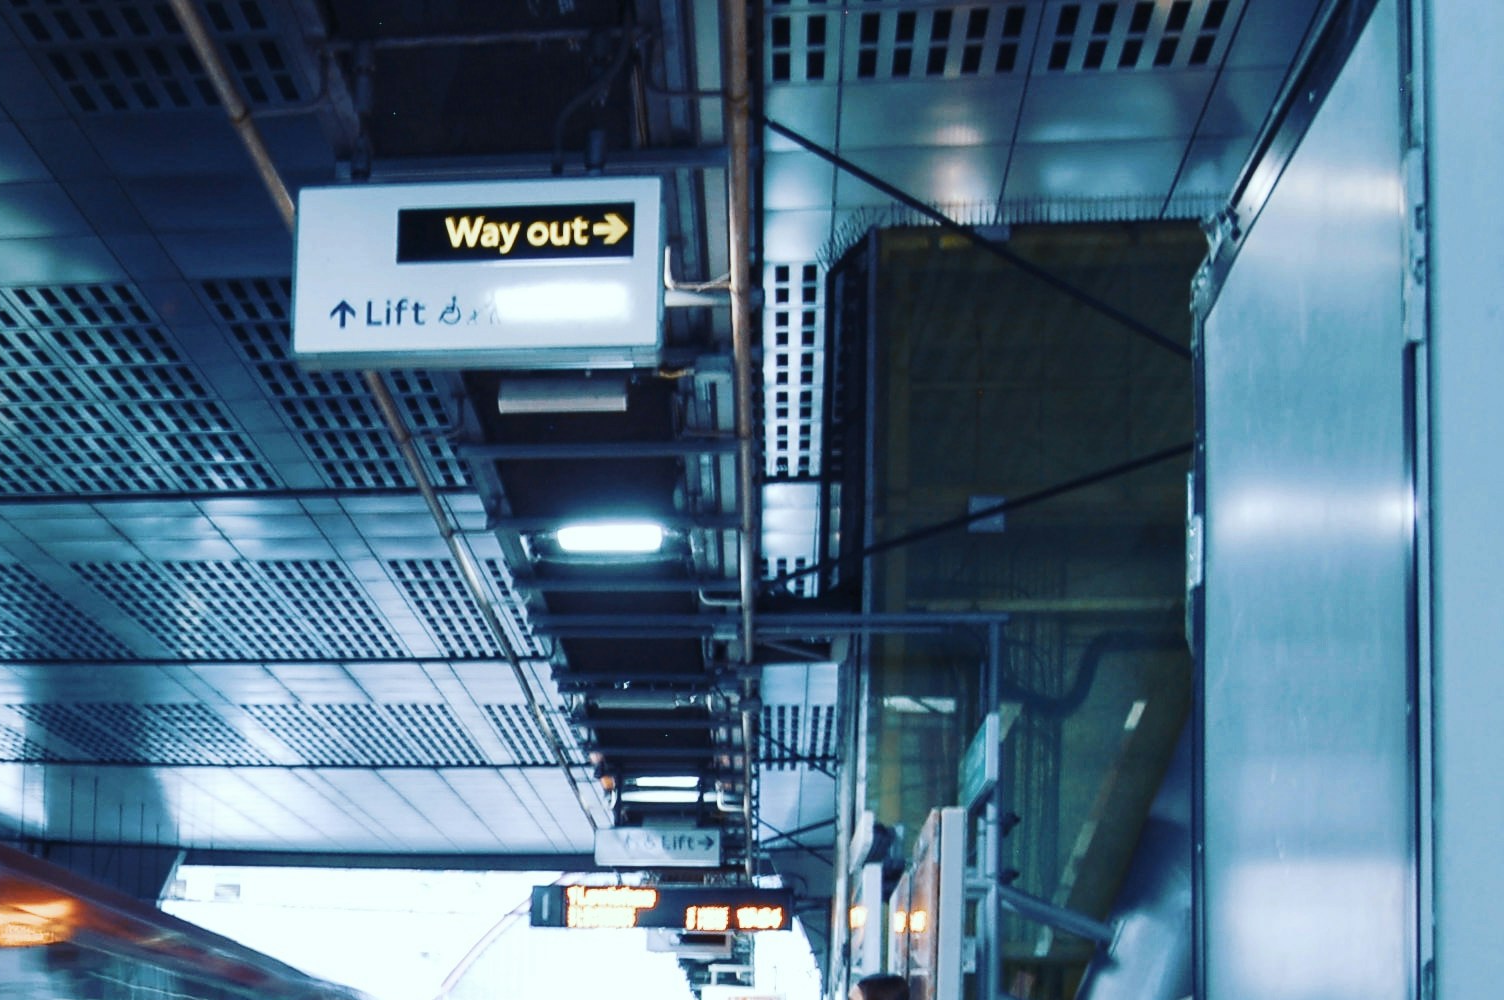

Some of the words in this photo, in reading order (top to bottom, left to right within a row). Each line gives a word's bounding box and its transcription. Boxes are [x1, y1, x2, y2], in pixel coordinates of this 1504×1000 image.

[445, 215, 521, 254] Way
[526, 215, 589, 247] out
[366, 298, 426, 327] Lift
[661, 834, 695, 851] Lift
